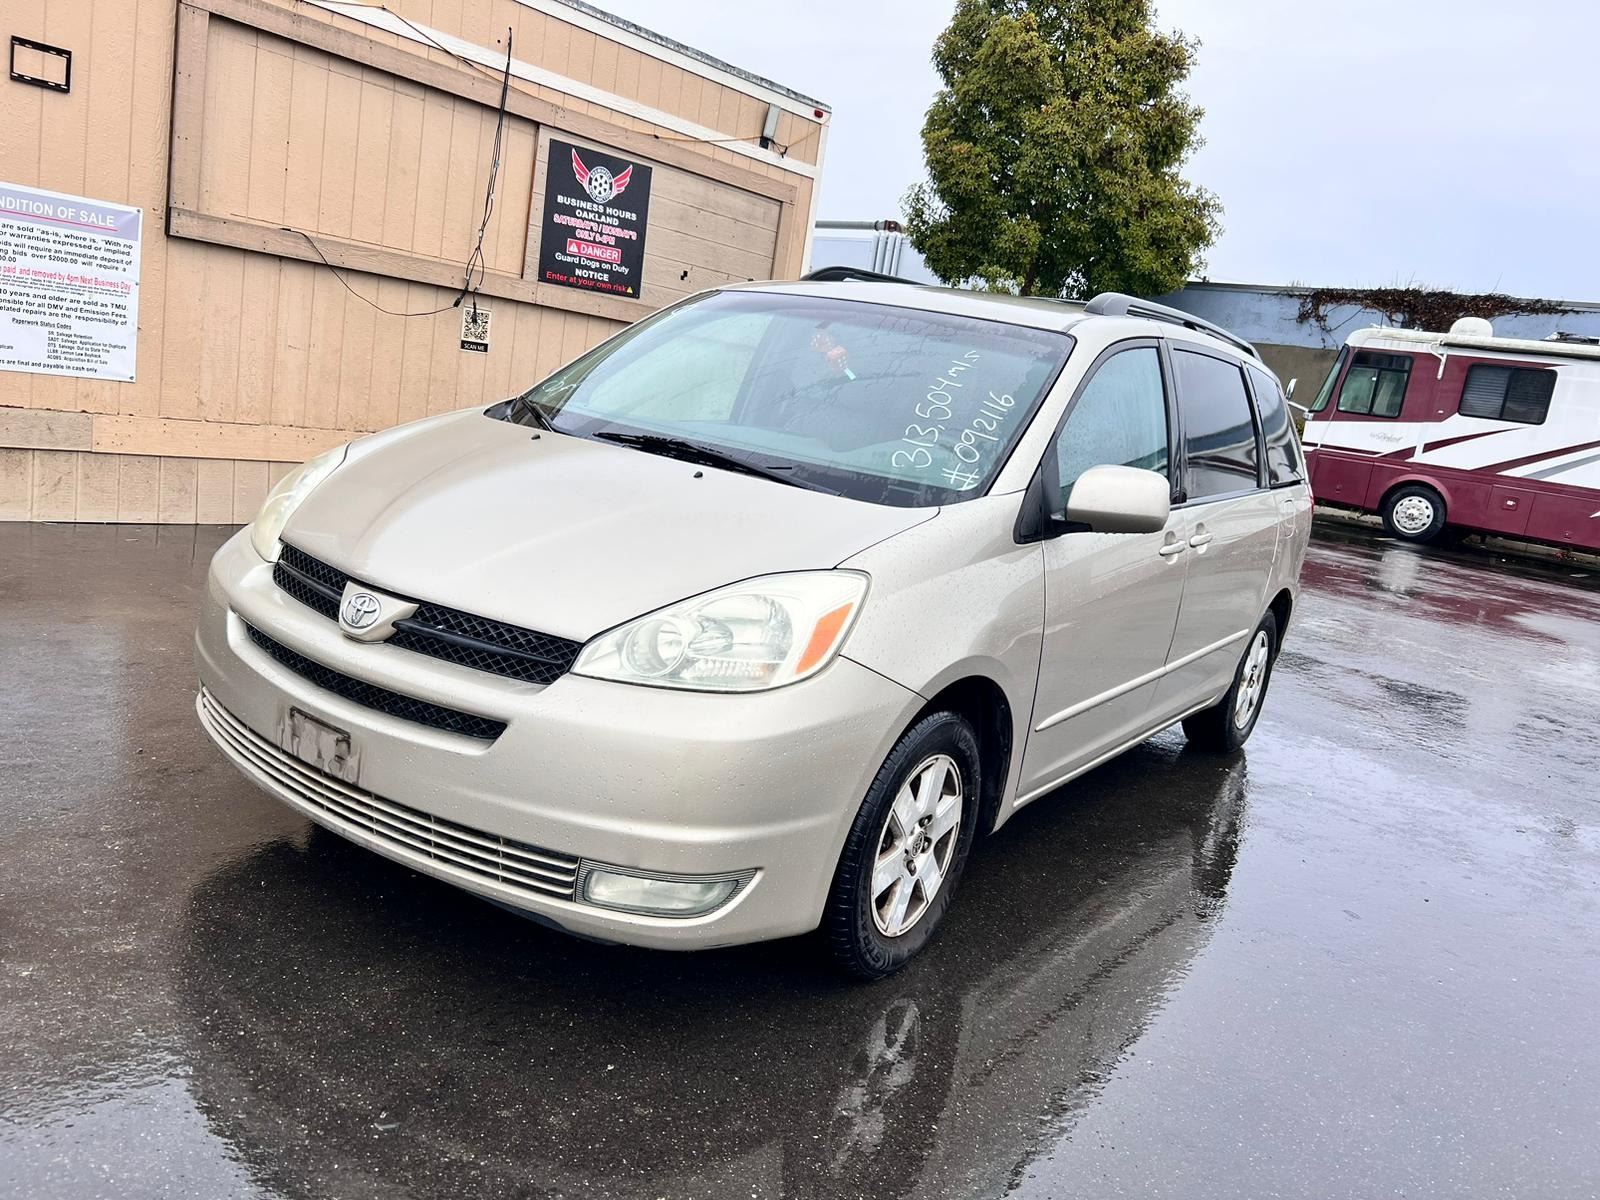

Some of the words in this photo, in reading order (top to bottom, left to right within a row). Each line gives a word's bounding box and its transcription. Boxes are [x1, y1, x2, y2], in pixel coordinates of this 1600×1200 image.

[57, 205, 76, 220] OF
[79, 210, 114, 226] SALE
[556, 194, 604, 213] BUSINESS
[606, 206, 637, 221] HOURS
[575, 208, 619, 226] OAKLAND
[9, 231, 50, 243] warranties
[52, 238, 91, 250] expressed
[16, 224, 33, 232] sold
[64, 232, 87, 241] where
[575, 228, 595, 241] ONLY
[27, 244, 51, 253] require
[63, 250, 98, 260] immediate
[99, 255, 123, 264] deposit
[580, 243, 618, 261] DANGER
[48, 254, 77, 264] $2000.00
[96, 263, 118, 271] require
[554, 252, 579, 264] Guard
[580, 257, 599, 269] Dogs
[601, 262, 610, 270] on
[611, 263, 629, 275] Duty
[3, 264, 16, 275] paid
[18, 266, 30, 275] and
[31, 269, 57, 279] removed
[58, 272, 65, 282] by
[66, 273, 78, 283] 4pm
[80, 275, 93, 285] Next
[94, 277, 119, 288] Business
[120, 281, 131, 291] Day
[546, 271, 567, 281] Enter
[569, 275, 577, 283] at
[578, 277, 593, 287] your
[593, 280, 611, 289] own
[612, 283, 627, 292] risk
[575, 268, 608, 281] NOTICE
[9, 290, 30, 298] years
[48, 294, 66, 302] older
[22, 307, 46, 316] repairs
[75, 314, 118, 325] responsibility
[79, 307, 109, 316] Emission
[11, 317, 38, 326] Paperwork
[891, 377, 962, 469] 313,504
[941, 391, 1015, 491] #092116
